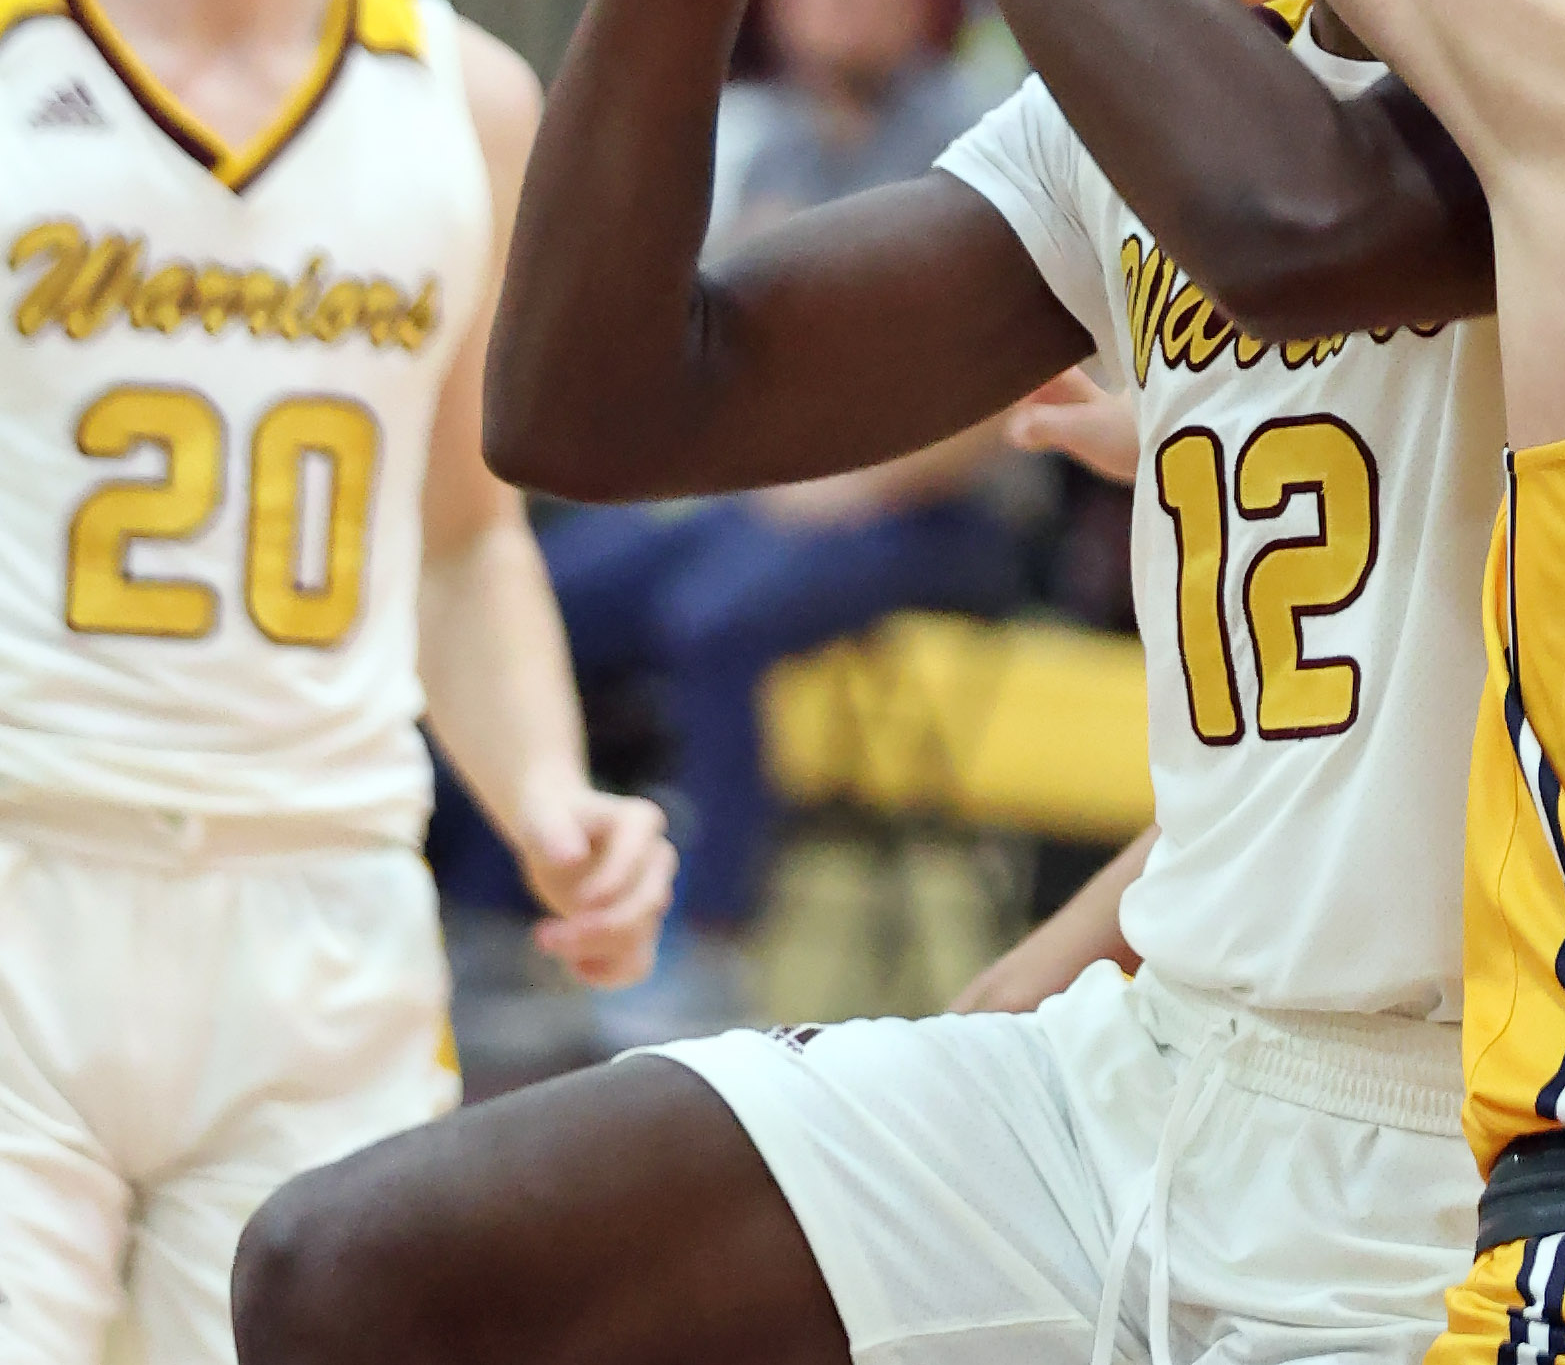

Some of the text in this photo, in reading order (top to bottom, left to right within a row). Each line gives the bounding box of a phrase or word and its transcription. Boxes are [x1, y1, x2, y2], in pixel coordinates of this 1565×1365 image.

[6, 217, 441, 354] Warriors
[64, 381, 384, 649] 20
[1155, 411, 1380, 747] 12
